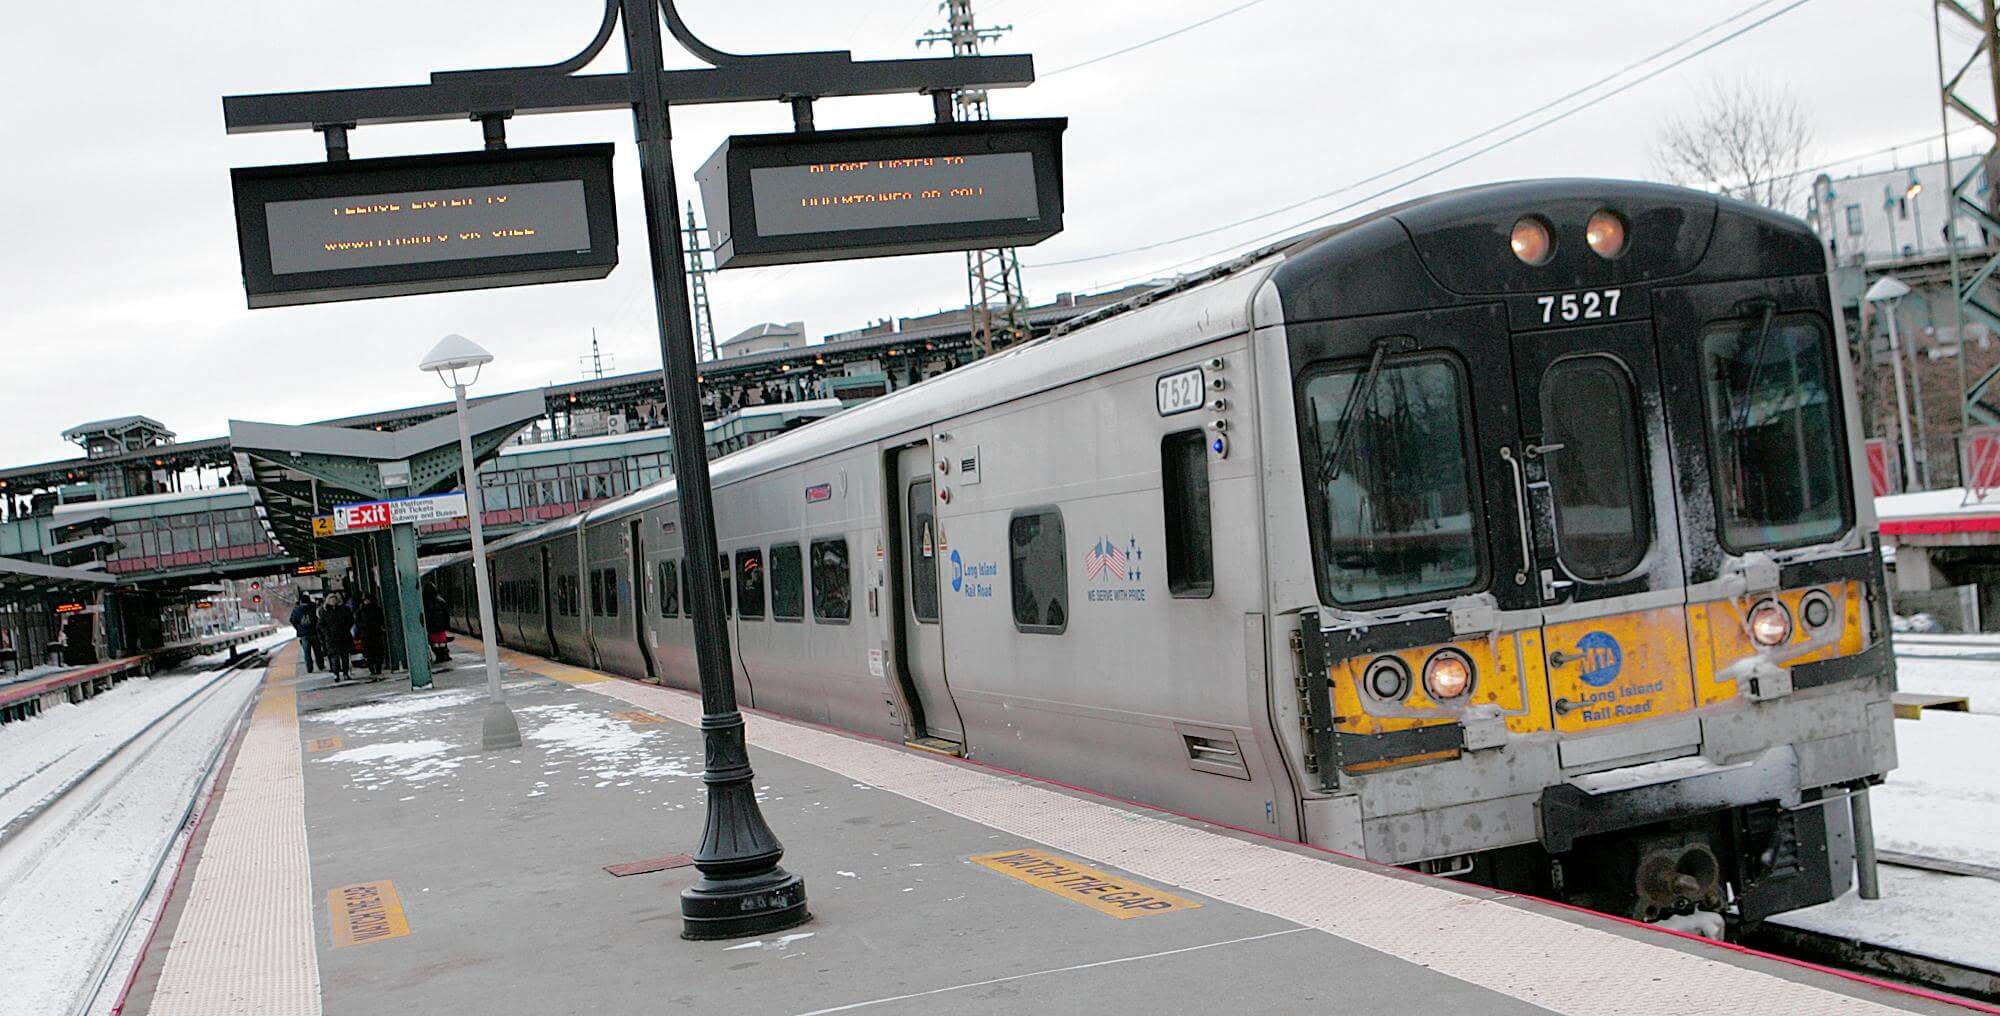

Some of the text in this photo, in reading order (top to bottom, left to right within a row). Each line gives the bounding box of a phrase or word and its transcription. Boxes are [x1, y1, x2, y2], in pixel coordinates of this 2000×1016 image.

[1537, 289, 1621, 324] 7527
[1161, 374, 1200, 410] 7527
[401, 499, 433, 507] Platforms
[409, 505, 434, 513] Tickets
[319, 518, 328, 528] 2
[347, 504, 386, 525] Exit
[964, 562, 978, 579] Long
[979, 560, 997, 577] Island
[965, 583, 993, 597] Rail Road
[1088, 589, 1145, 601] WE SERVE WITH PRIDE
[1582, 647, 1617, 674] MTA
[1580, 680, 1664, 703] Long Island
[1583, 700, 1652, 722] Rail Road
[992, 852, 1173, 910] WATCH THE GAP
[349, 912, 390, 941] WATCH
